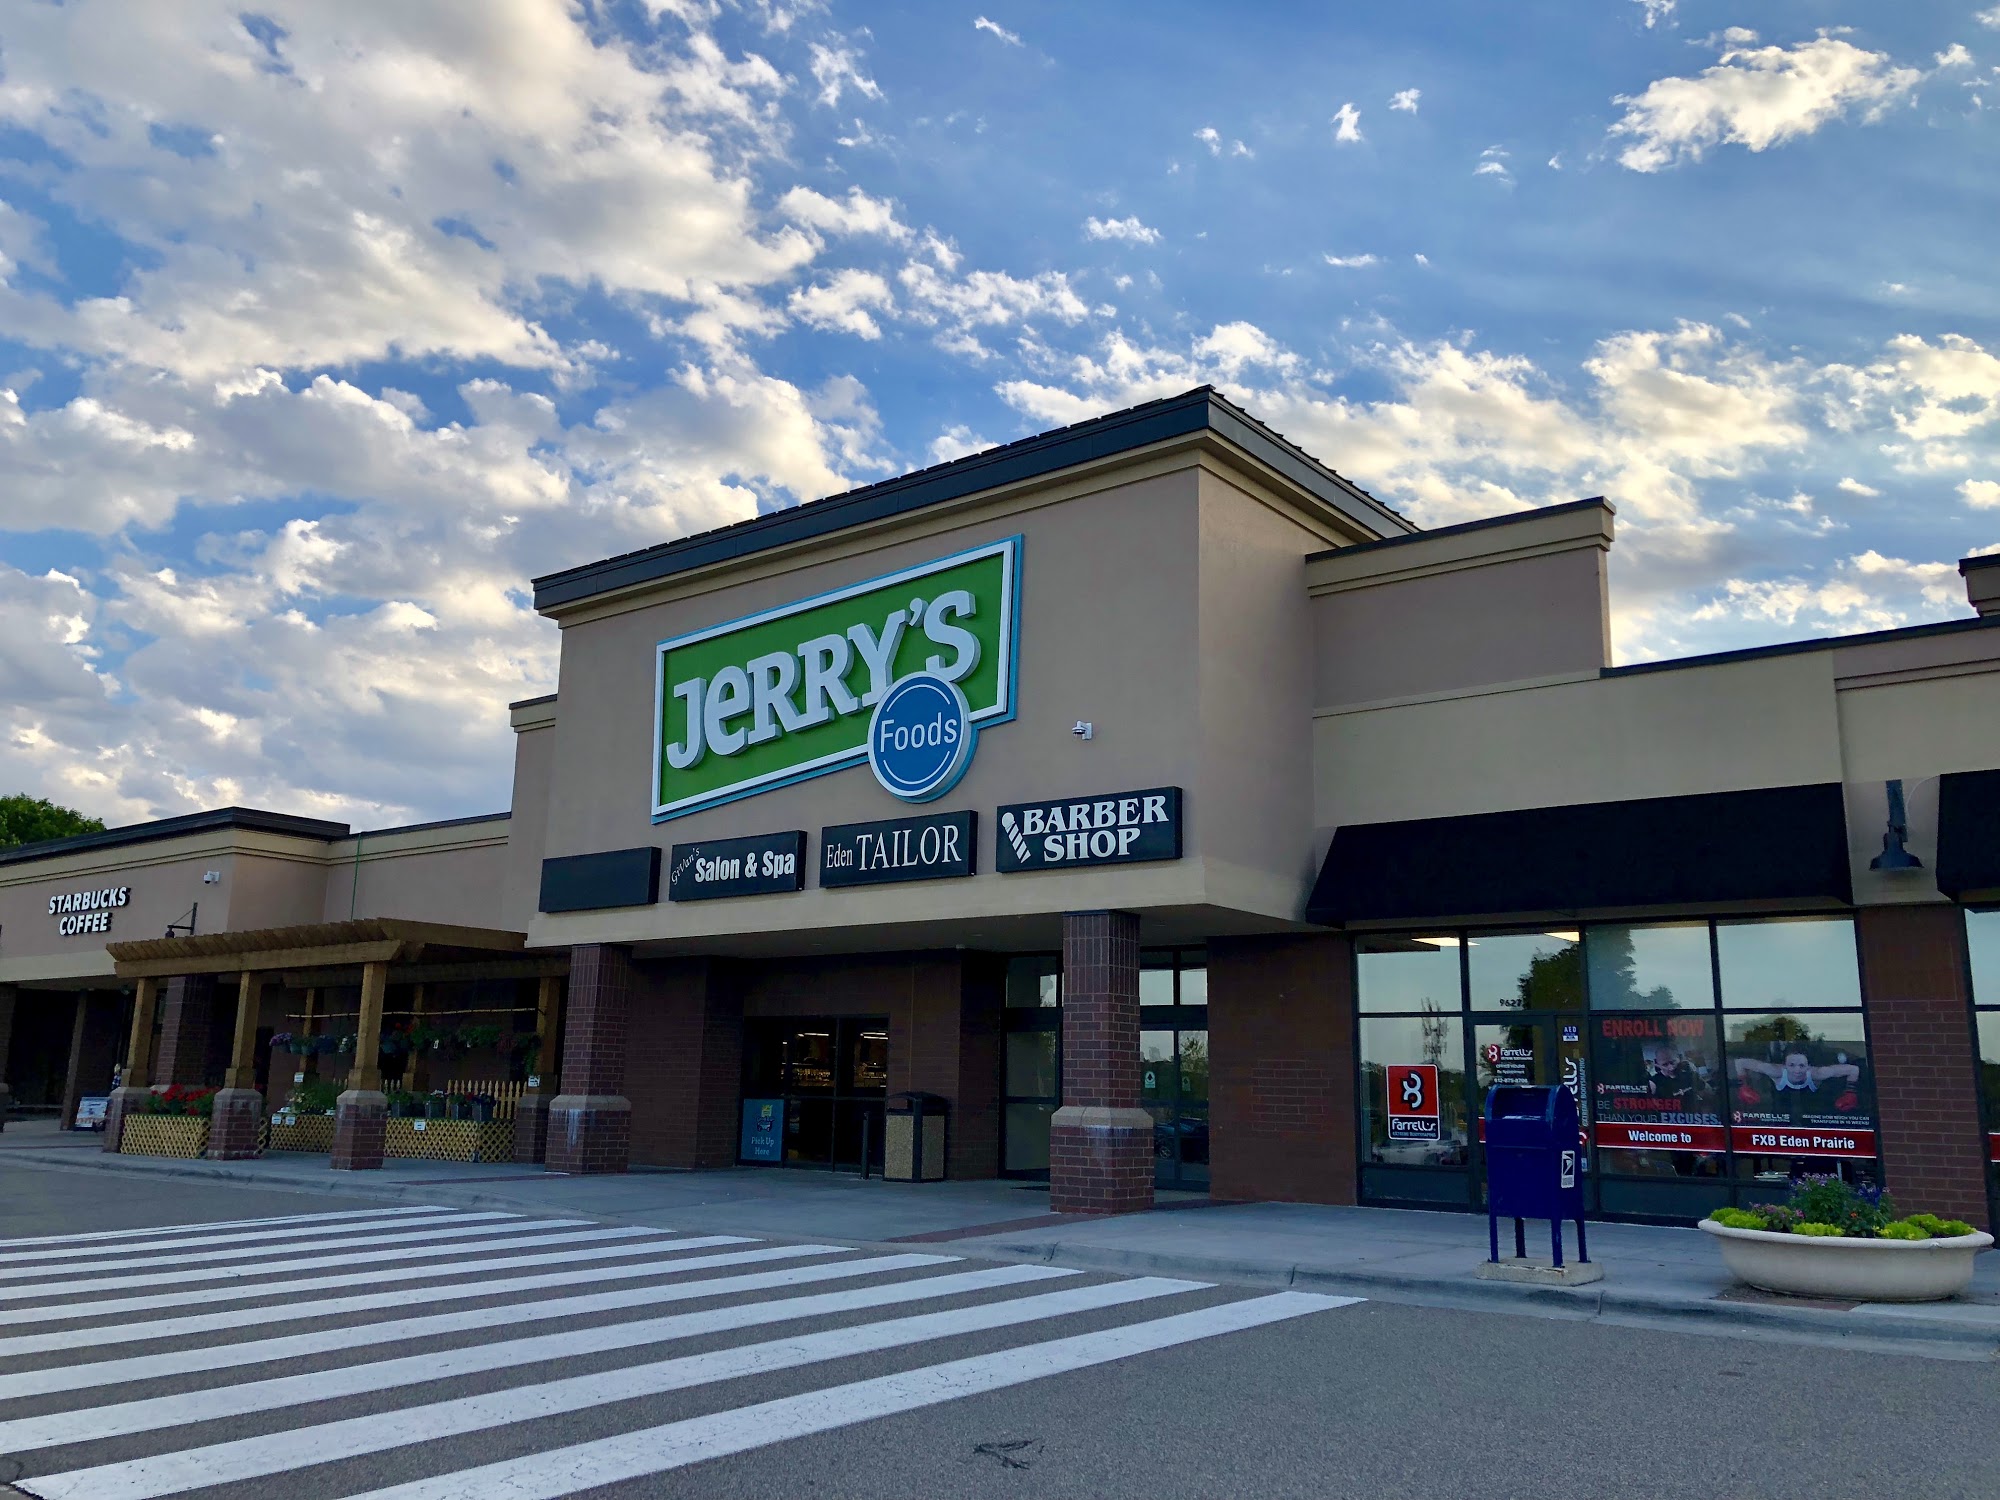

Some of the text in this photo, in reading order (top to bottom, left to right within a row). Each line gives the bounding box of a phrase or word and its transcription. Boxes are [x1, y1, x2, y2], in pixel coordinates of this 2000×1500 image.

[880, 713, 958, 753] Foods
[1022, 795, 1169, 836] BARBER
[826, 825, 962, 871] Eden TAILOR
[1044, 827, 1141, 862] SHOP
[695, 850, 795, 882] Salon & Spa
[48, 886, 130, 915] STARBUCKS
[59, 912, 111, 936] COFFEE
[1499, 998, 1522, 1008] 9627
[1602, 1018, 1704, 1037] ENROLL NOW
[1597, 1098, 1682, 1111] BE STRONGER
[1597, 1112, 1722, 1126] THAN YOUR EXCUSES.
[751, 1136, 775, 1148] Pick Up
[1628, 1129, 1692, 1143] Welcome to
[1752, 1134, 1855, 1149] FXB Eden Prairie
[754, 1146, 770, 1156] Here
